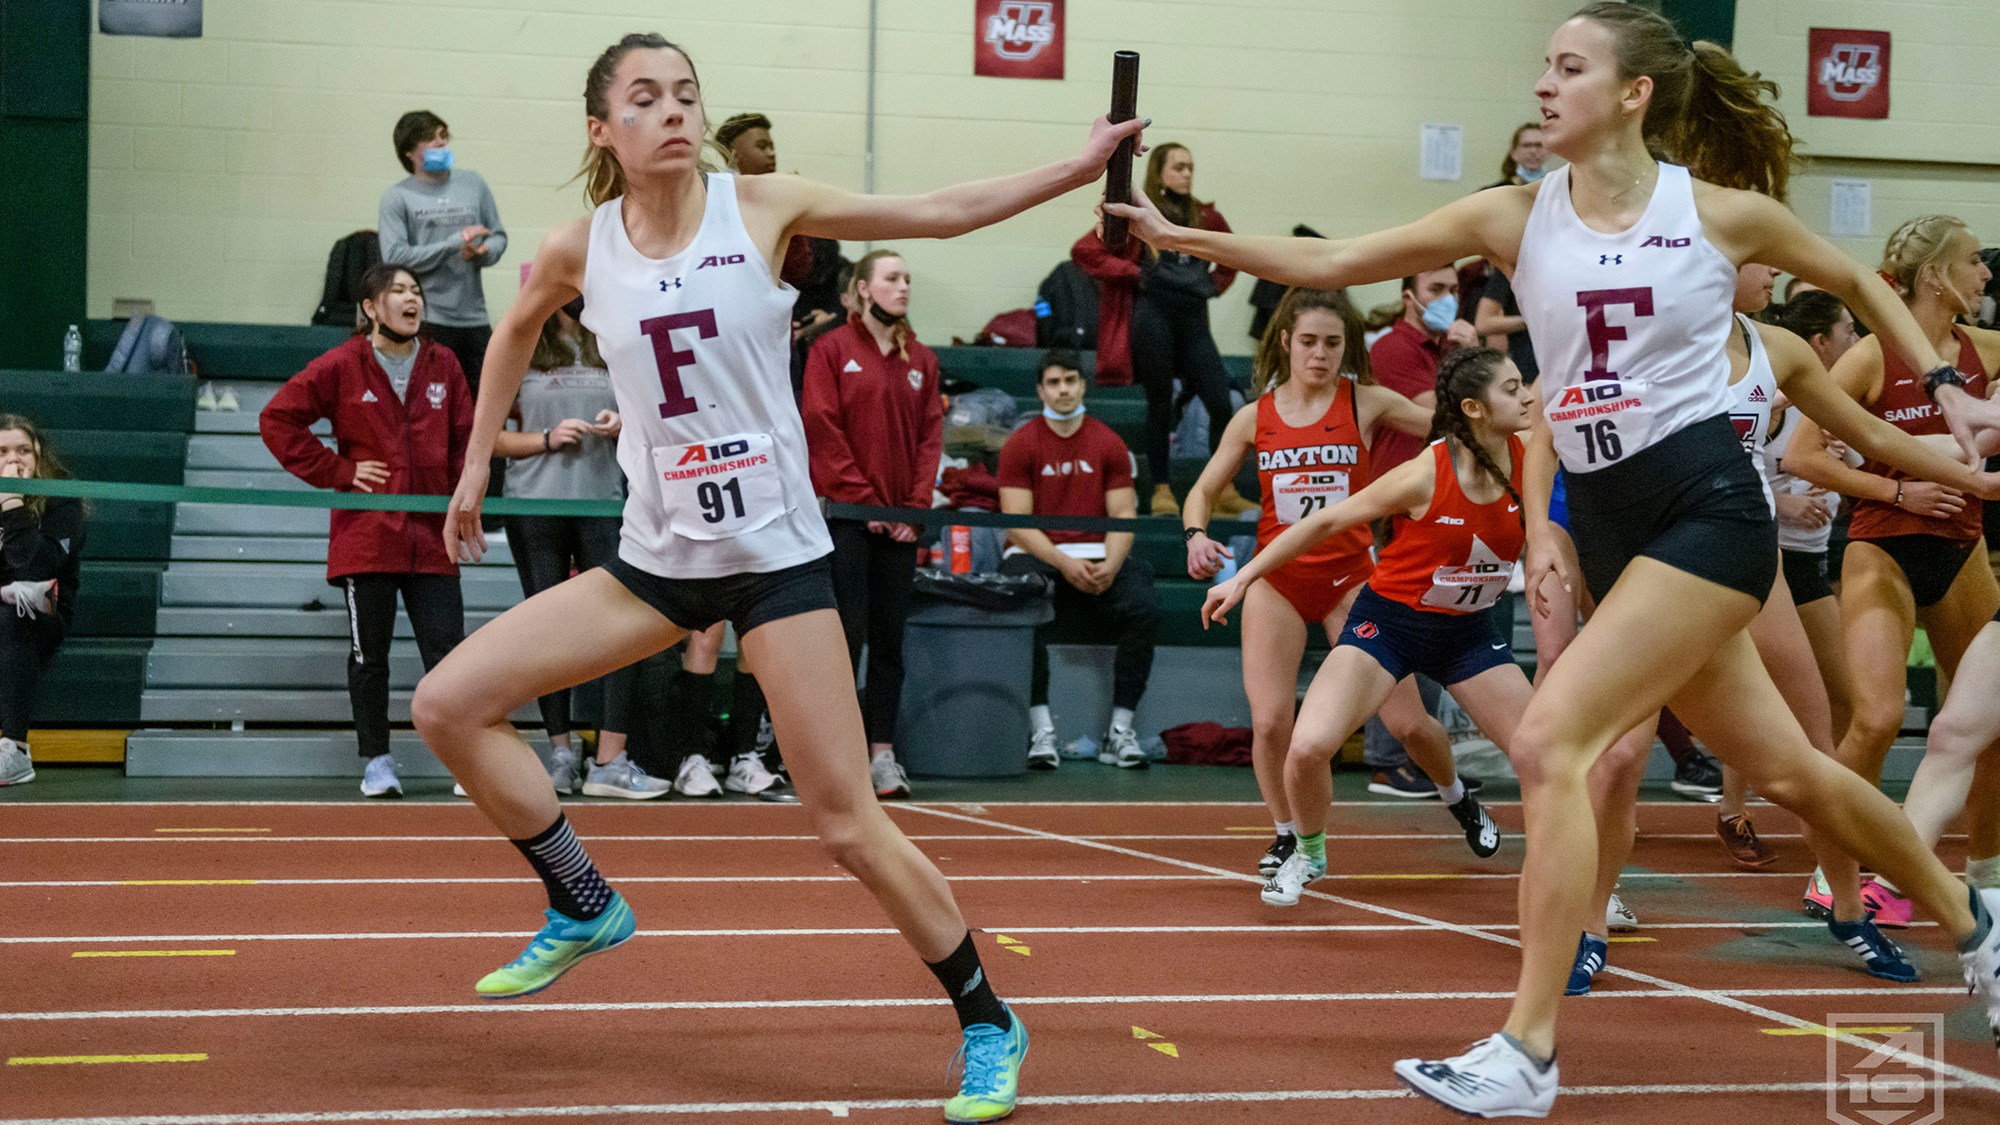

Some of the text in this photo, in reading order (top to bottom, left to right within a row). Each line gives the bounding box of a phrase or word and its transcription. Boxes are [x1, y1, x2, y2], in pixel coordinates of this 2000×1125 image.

[1639, 236, 1691, 248] A10
[696, 254, 746, 270] A10
[1576, 287, 1654, 382] F
[640, 308, 719, 419] F
[1558, 383, 1623, 408] A10
[1549, 397, 1642, 422] CHAMPIONSHIPS
[1884, 404, 1932, 422] SAINT
[676, 439, 750, 467] A10
[1575, 418, 1623, 465] 76
[663, 453, 768, 481] CHAMPIONSHIPS
[1258, 444, 1359, 471] DAYTON
[1279, 485, 1344, 494] CHAMPIONSHIPS
[1290, 474, 1335, 486] A10
[697, 476, 746, 524] 91
[1300, 495, 1326, 520] 27
[1439, 575, 1508, 583] CHAMPIONSHIPS
[1454, 584, 1483, 605] 71
